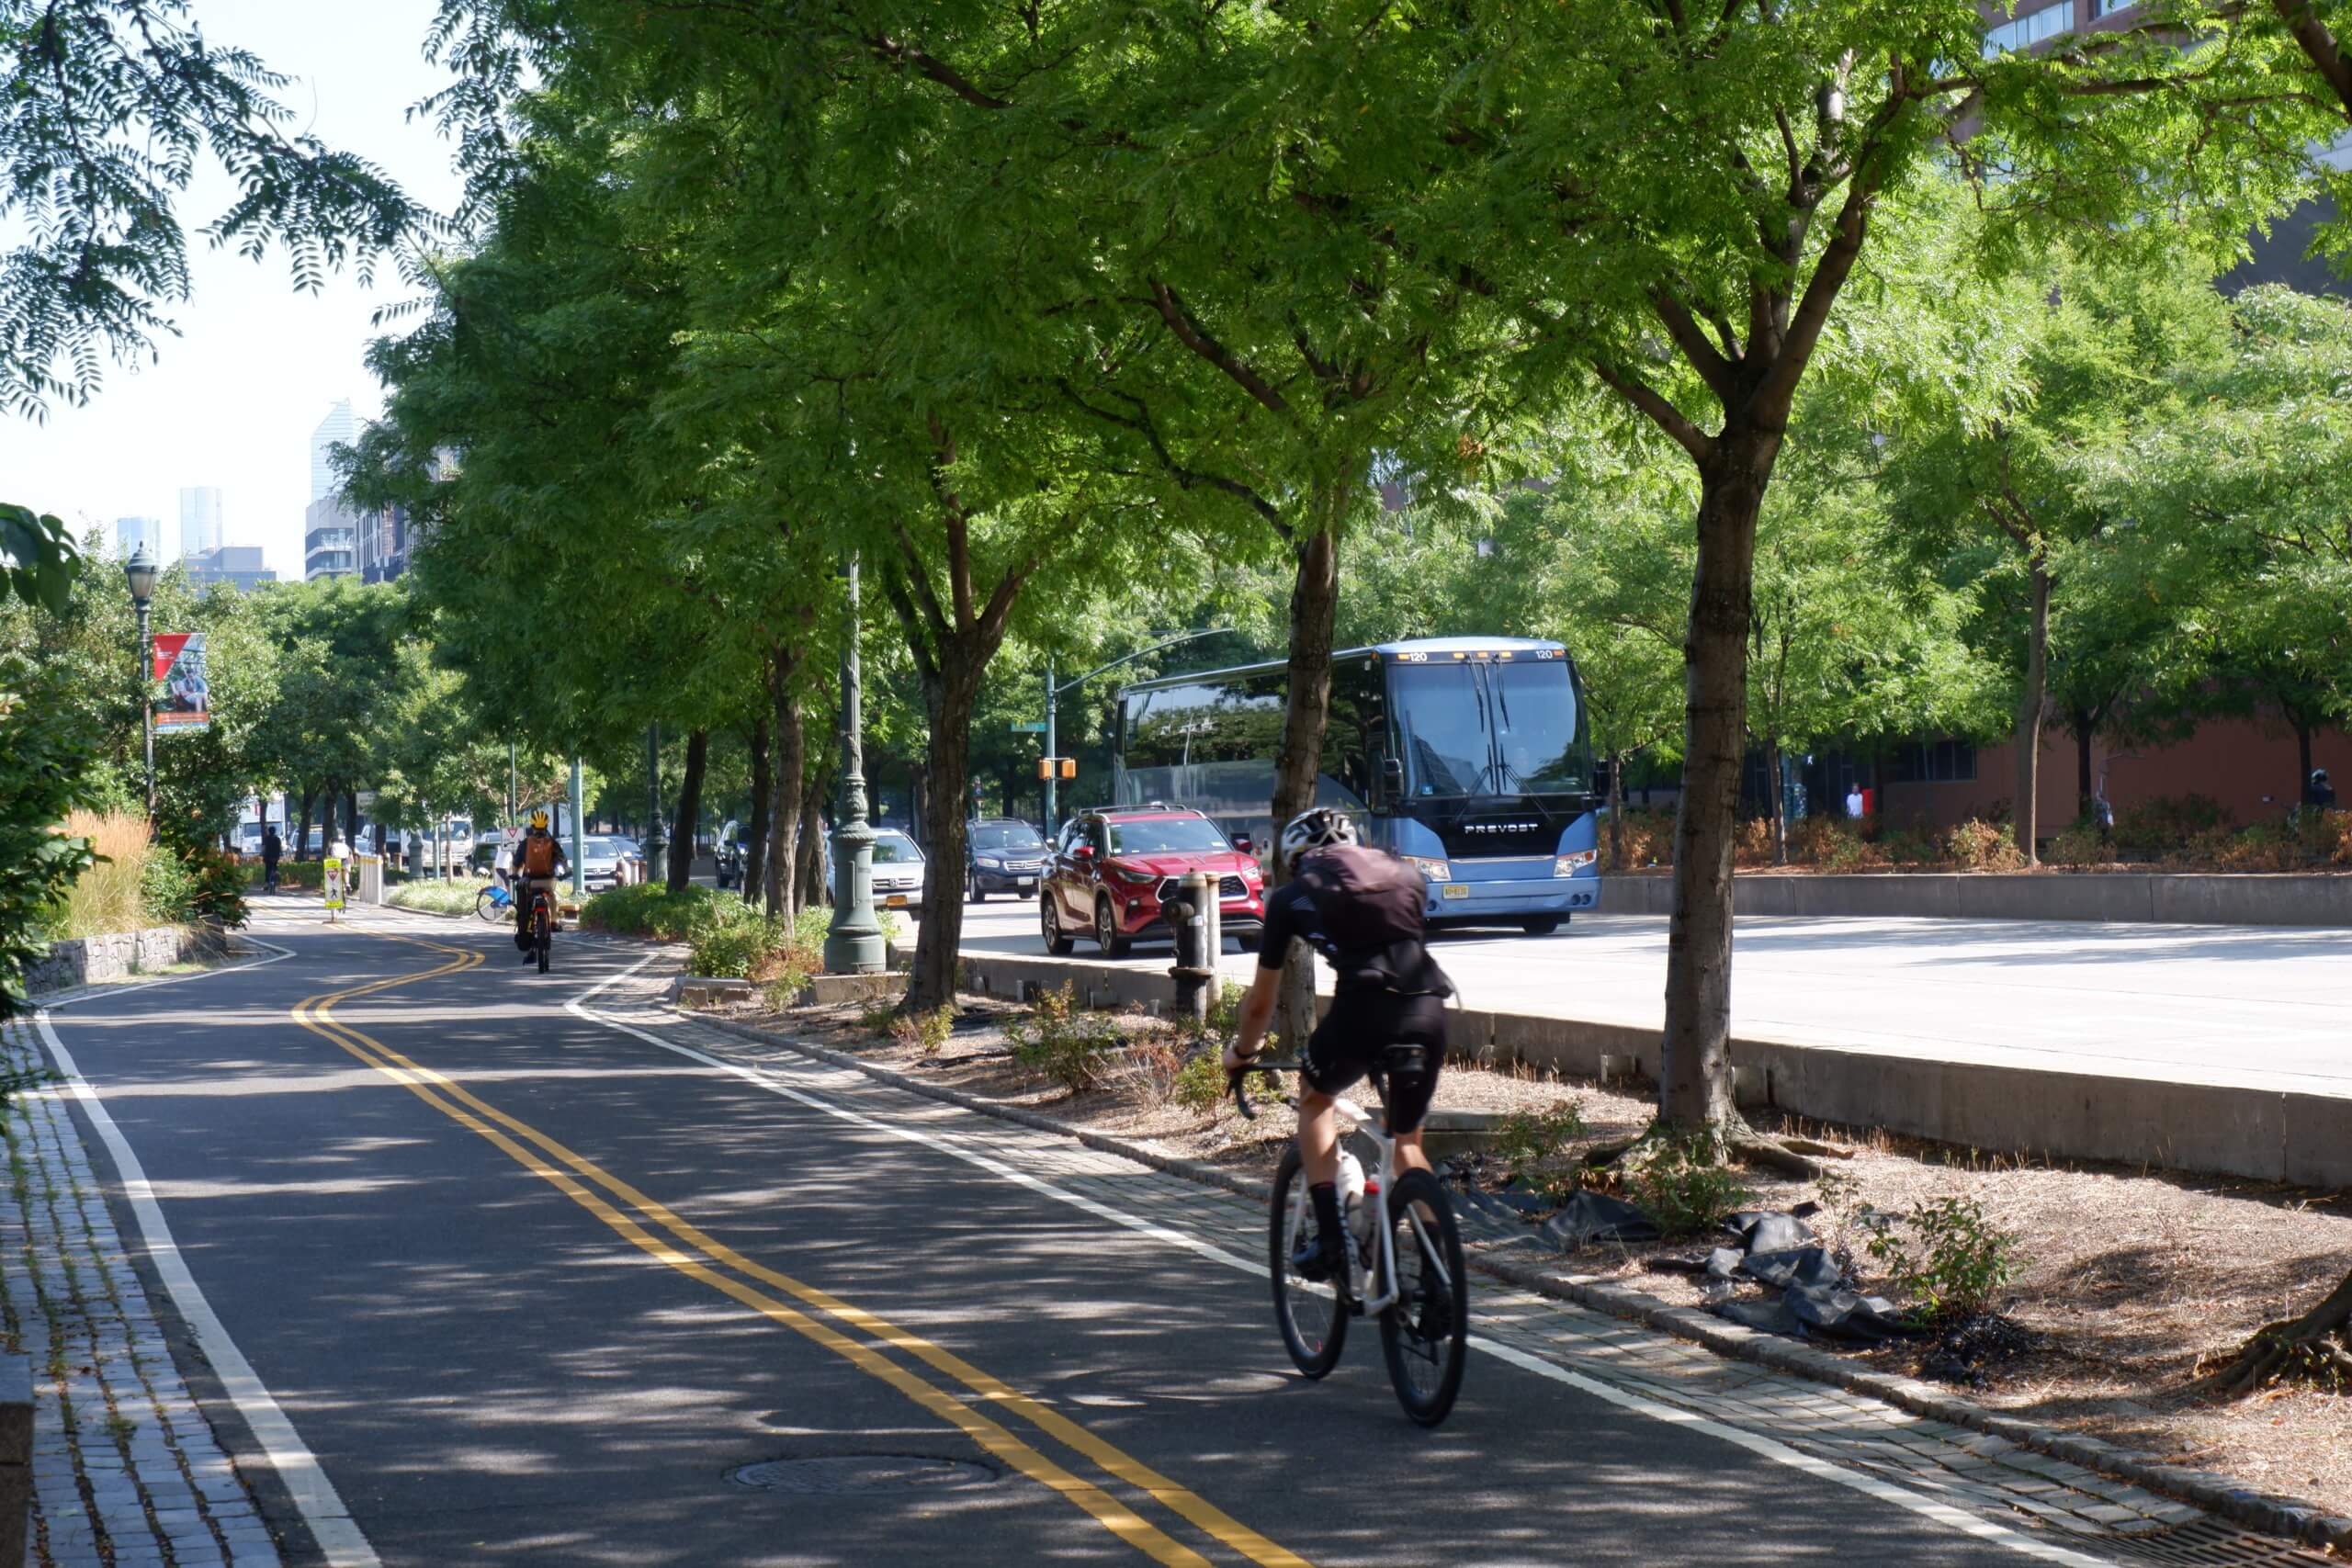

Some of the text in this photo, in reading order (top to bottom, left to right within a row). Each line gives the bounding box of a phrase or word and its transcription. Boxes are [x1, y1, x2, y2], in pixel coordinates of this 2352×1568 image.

[1410, 652, 1428, 662] 120
[1536, 650, 1553, 660] 120
[1464, 823, 1539, 834] PREVOST
